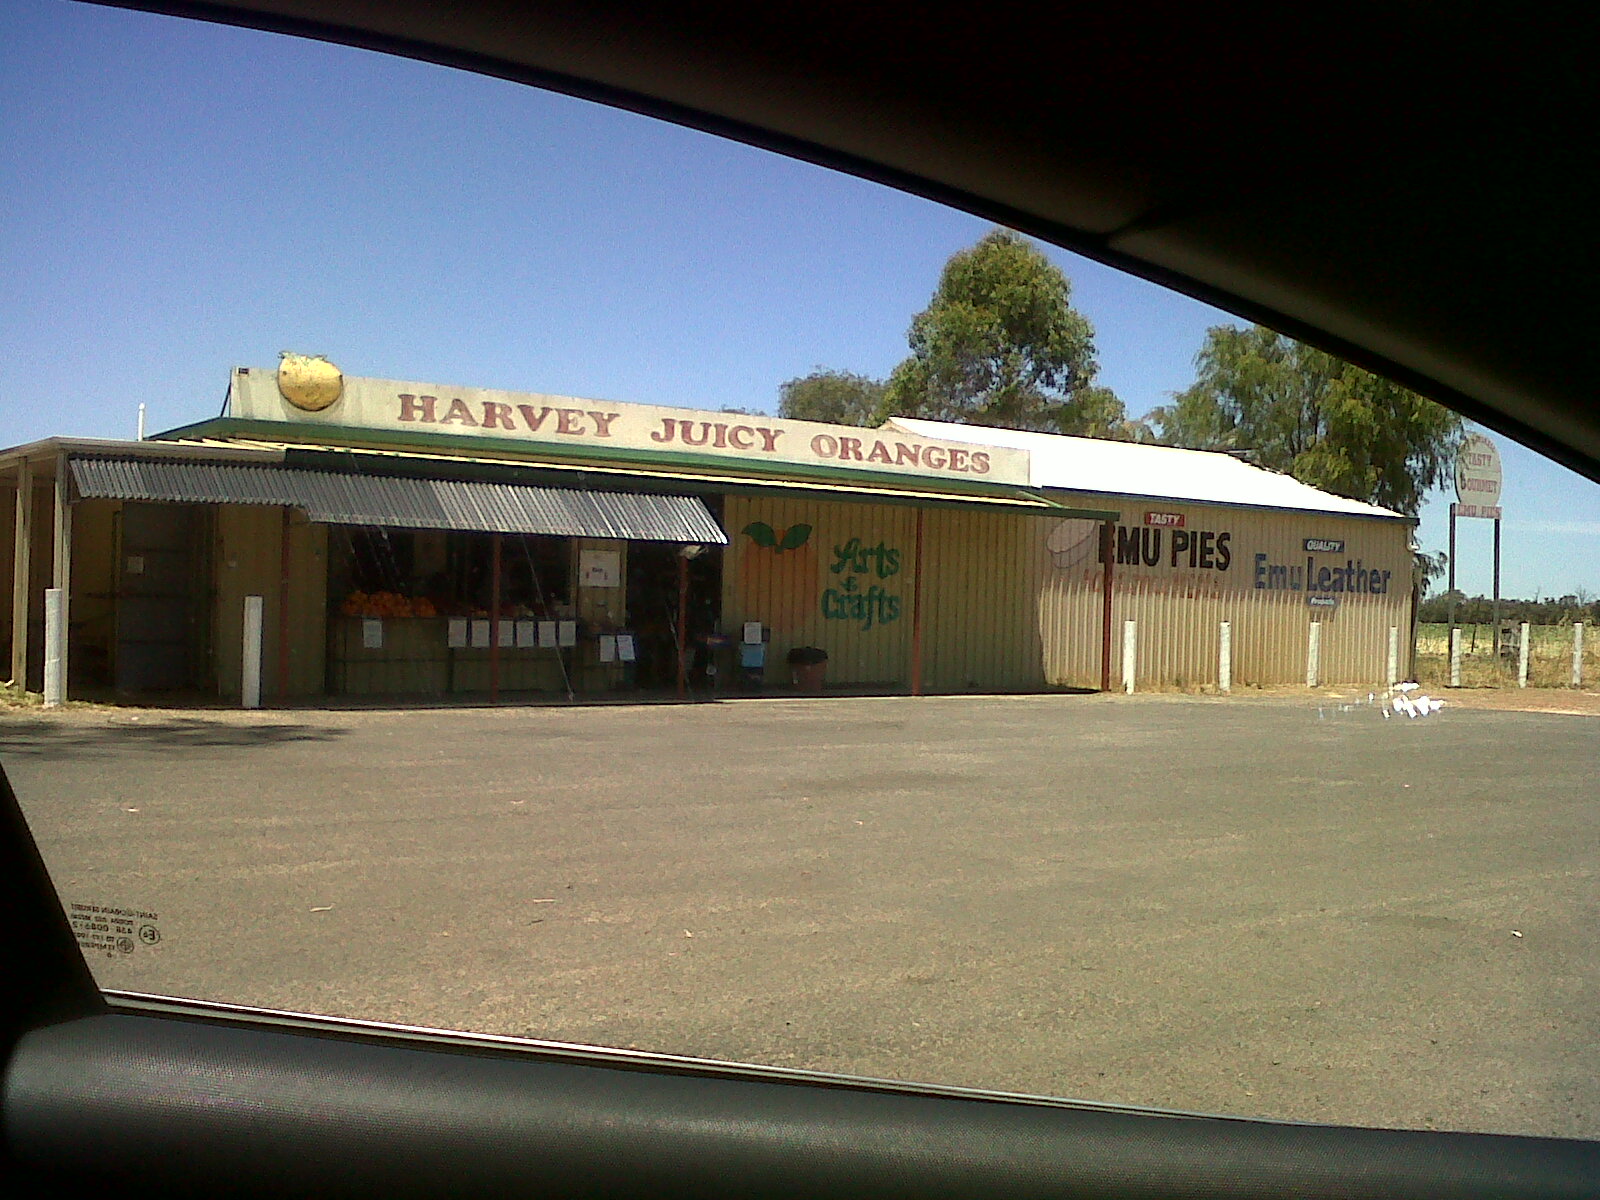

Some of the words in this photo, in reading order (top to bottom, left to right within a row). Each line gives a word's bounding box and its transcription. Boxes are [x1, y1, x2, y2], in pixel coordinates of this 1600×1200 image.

[397, 393, 621, 438] HARVEY
[650, 418, 785, 452] JUICY
[810, 434, 991, 474] ORANGES
[1468, 452, 1492, 467] TASTY
[1149, 513, 1181, 526] TASTY
[830, 538, 900, 579] Arts
[1098, 524, 1161, 567] EMU
[1171, 529, 1231, 571] PIES
[1306, 540, 1341, 552] QUALITY
[1255, 553, 1302, 590] Emu
[1306, 556, 1391, 593] Leather
[821, 585, 901, 631] Crafts
